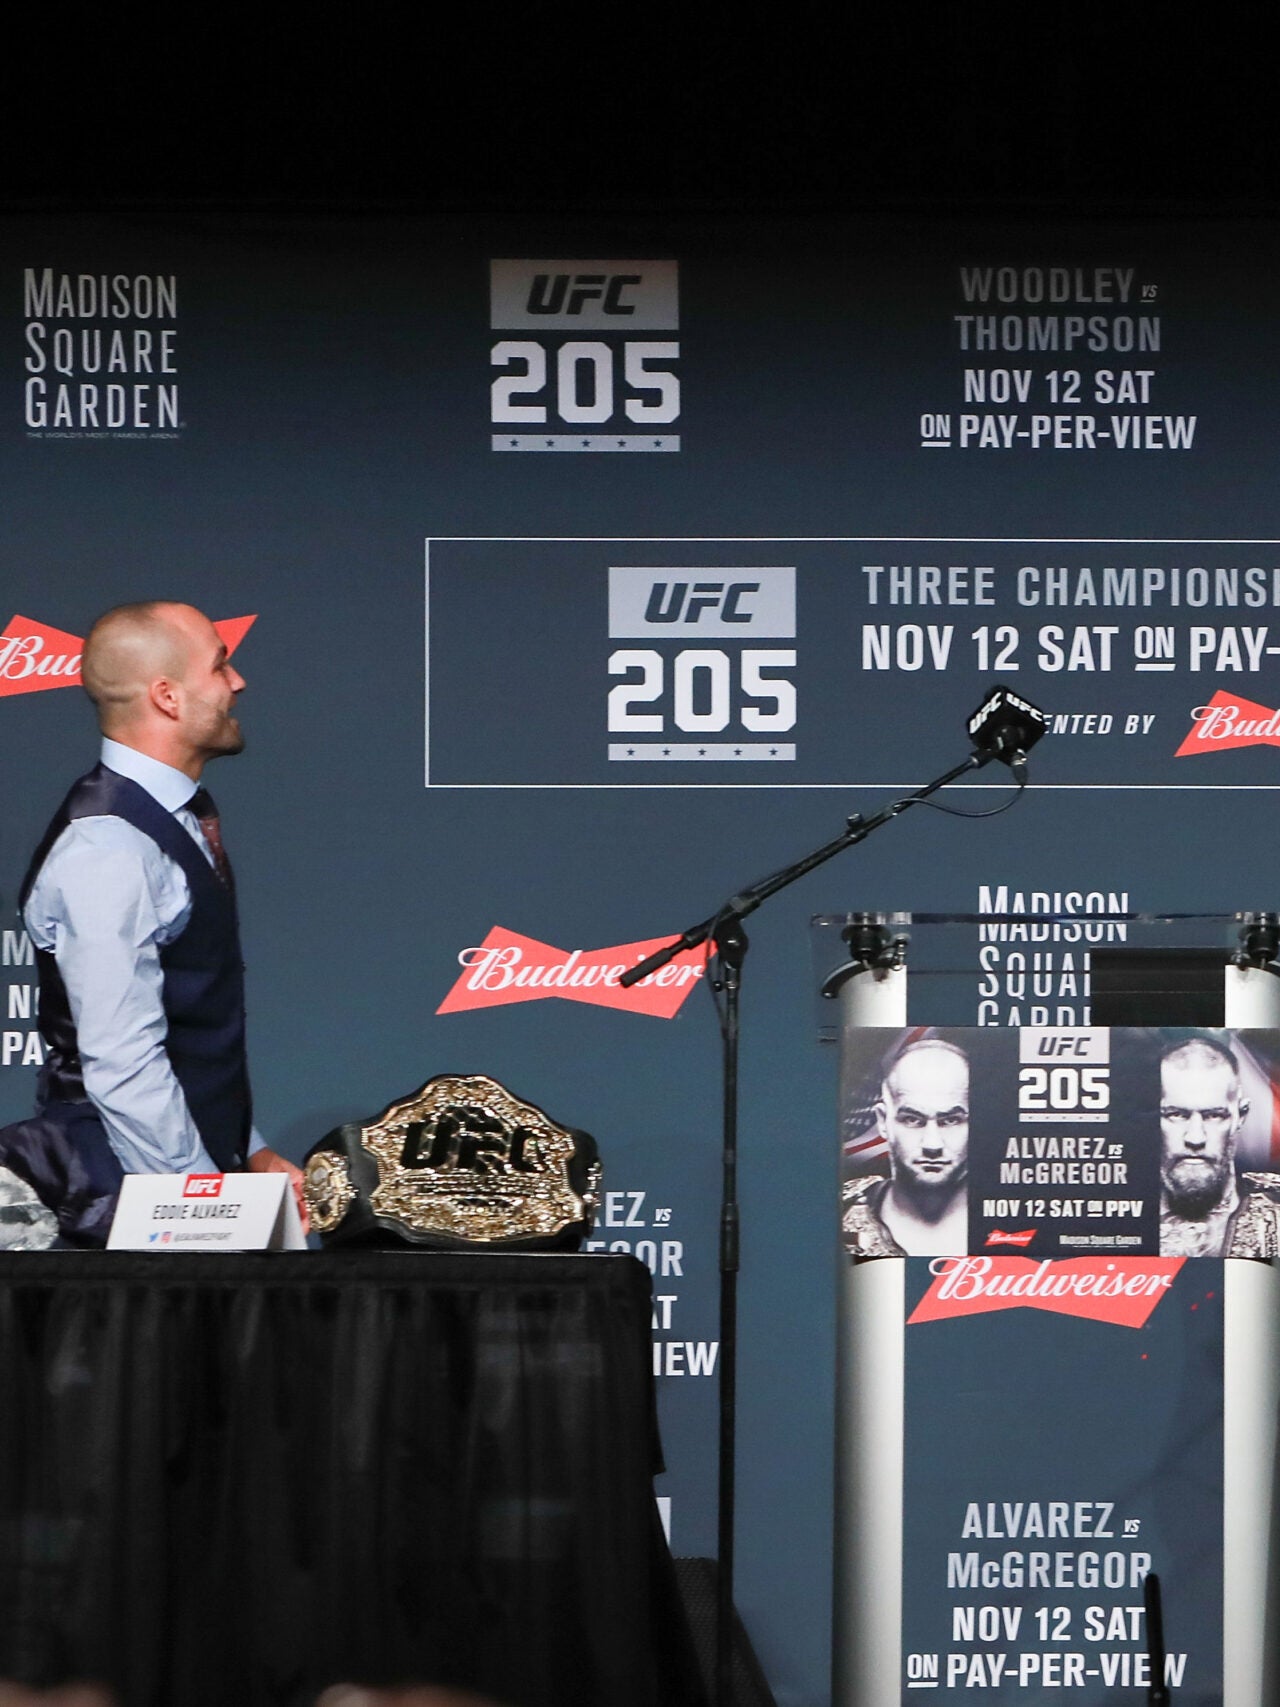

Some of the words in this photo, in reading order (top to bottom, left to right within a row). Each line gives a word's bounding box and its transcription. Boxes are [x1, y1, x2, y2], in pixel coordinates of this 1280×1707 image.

[24, 268, 177, 318] MADISON
[526, 275, 643, 315] UFC
[960, 267, 1134, 303] WOODLEY
[24, 322, 178, 377] SQUARE
[954, 316, 1161, 351] THOMPSON
[490, 341, 681, 424] 205
[963, 369, 1033, 403] NOV
[1045, 370, 1081, 403] 12
[1094, 370, 1155, 404] SAT
[25, 377, 178, 428] GARDEN
[920, 413, 951, 440] ON
[959, 414, 1197, 449] PAY-PER-VIEW
[644, 582, 761, 623] UFC
[861, 566, 996, 606] THREE
[861, 624, 954, 671] NOV
[971, 625, 1019, 672] 12
[1037, 625, 1119, 672] SAT
[1133, 625, 1176, 659] ON
[608, 649, 797, 732] 205
[1006, 692, 1043, 722] UFC
[1124, 714, 1156, 735] BY
[978, 885, 1129, 942] MADISON
[977, 946, 1091, 1000] SQUA
[1038, 1037, 1091, 1056] UFC
[1018, 1068, 1110, 1109] 205
[402, 1106, 550, 1171] UFC
[1005, 1137, 1106, 1159] ALVAREZ
[186, 1179, 221, 1194] UFC
[1000, 1162, 1128, 1185] McGREGOR
[983, 1199, 1020, 1217] NOV
[1025, 1199, 1045, 1217] 12
[1050, 1200, 1084, 1218] SAT
[1105, 1200, 1144, 1218] PPV
[929, 1256, 1172, 1300] Budweiser
[961, 1502, 1114, 1538] ALVAREZ
[947, 1551, 1151, 1588] McGREGOR
[952, 1606, 1022, 1641] NOV
[1035, 1606, 1071, 1641] 12
[1084, 1606, 1146, 1641] SAT
[907, 1653, 938, 1680] ON
[947, 1653, 1187, 1688] PAY-PER-VIEW
